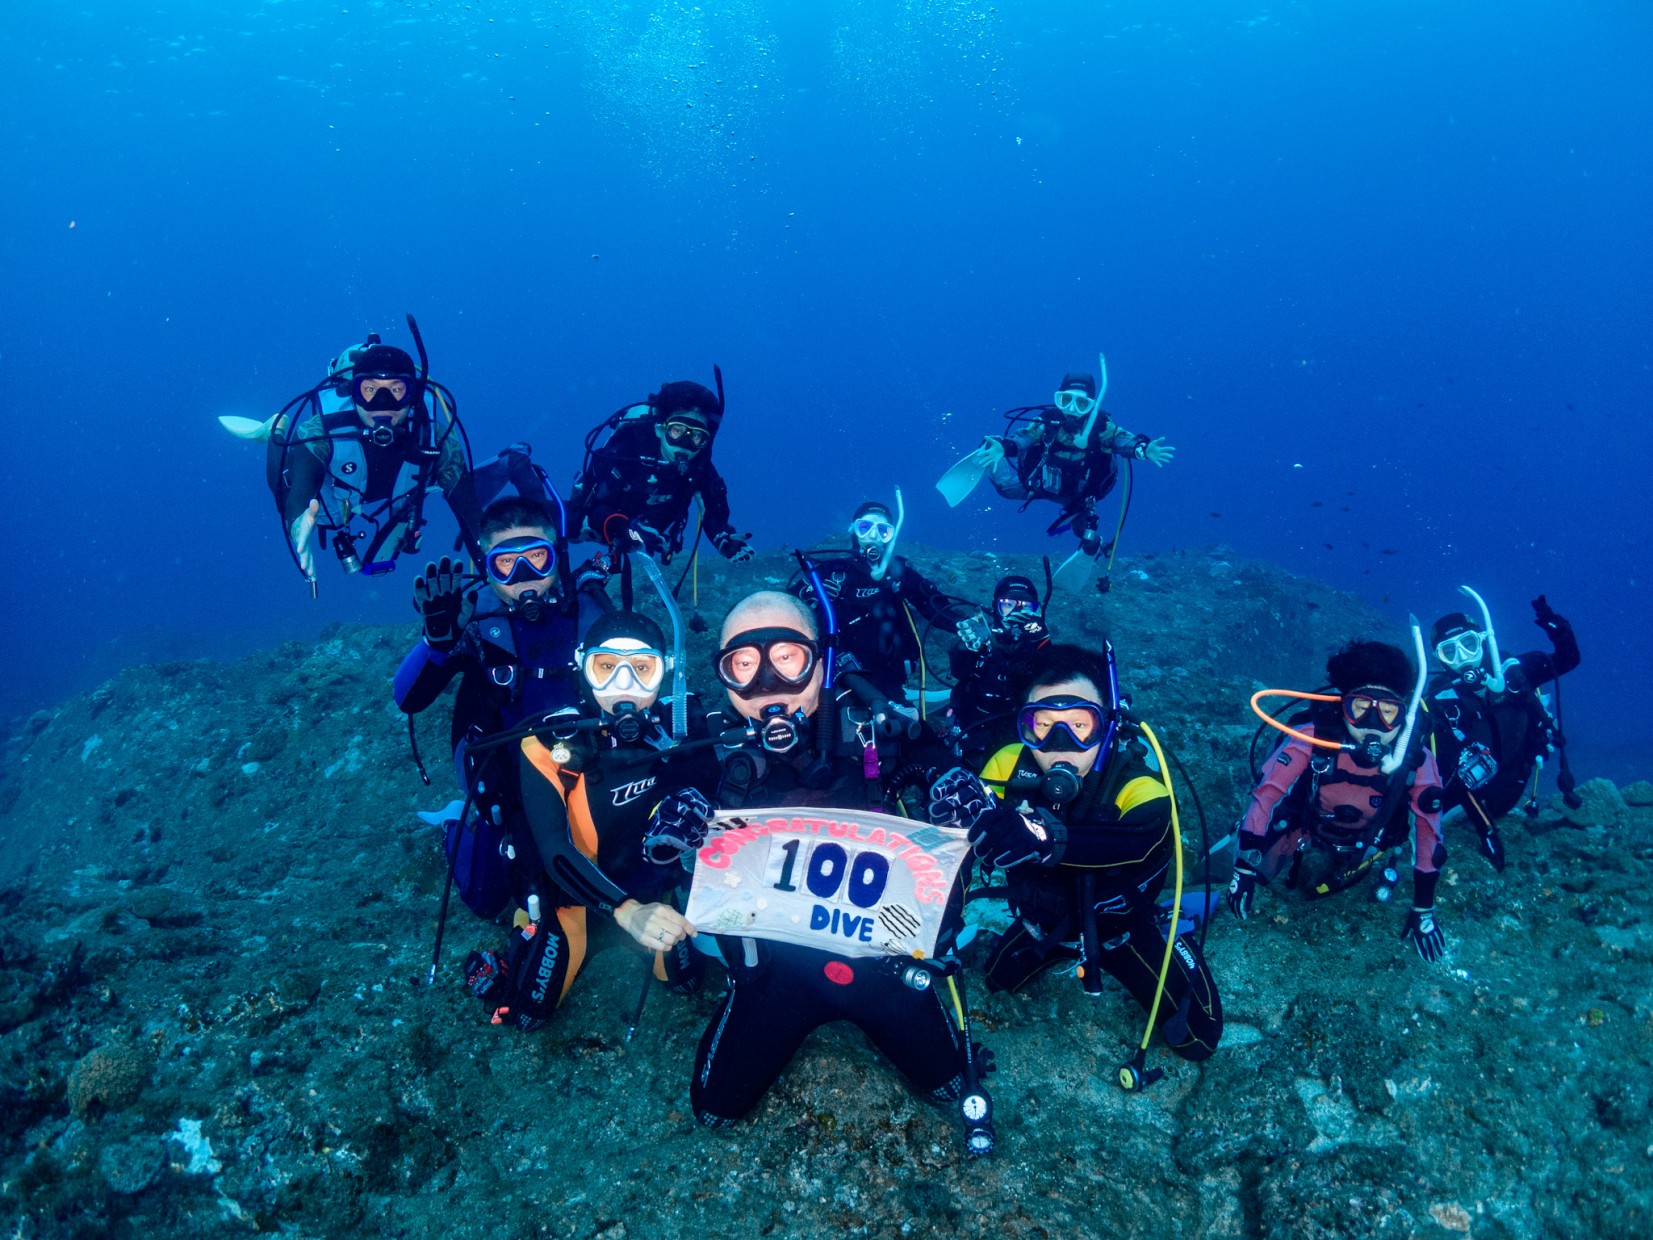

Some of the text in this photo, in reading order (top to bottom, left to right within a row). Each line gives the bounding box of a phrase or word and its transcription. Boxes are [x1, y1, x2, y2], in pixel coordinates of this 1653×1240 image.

[698, 817, 948, 905] CONGRATULATIONS
[773, 838, 890, 909] 100
[810, 904, 875, 942] DIVE
[1174, 941, 1196, 969] MOBBY'S
[531, 931, 560, 1002] MOBBY'S
